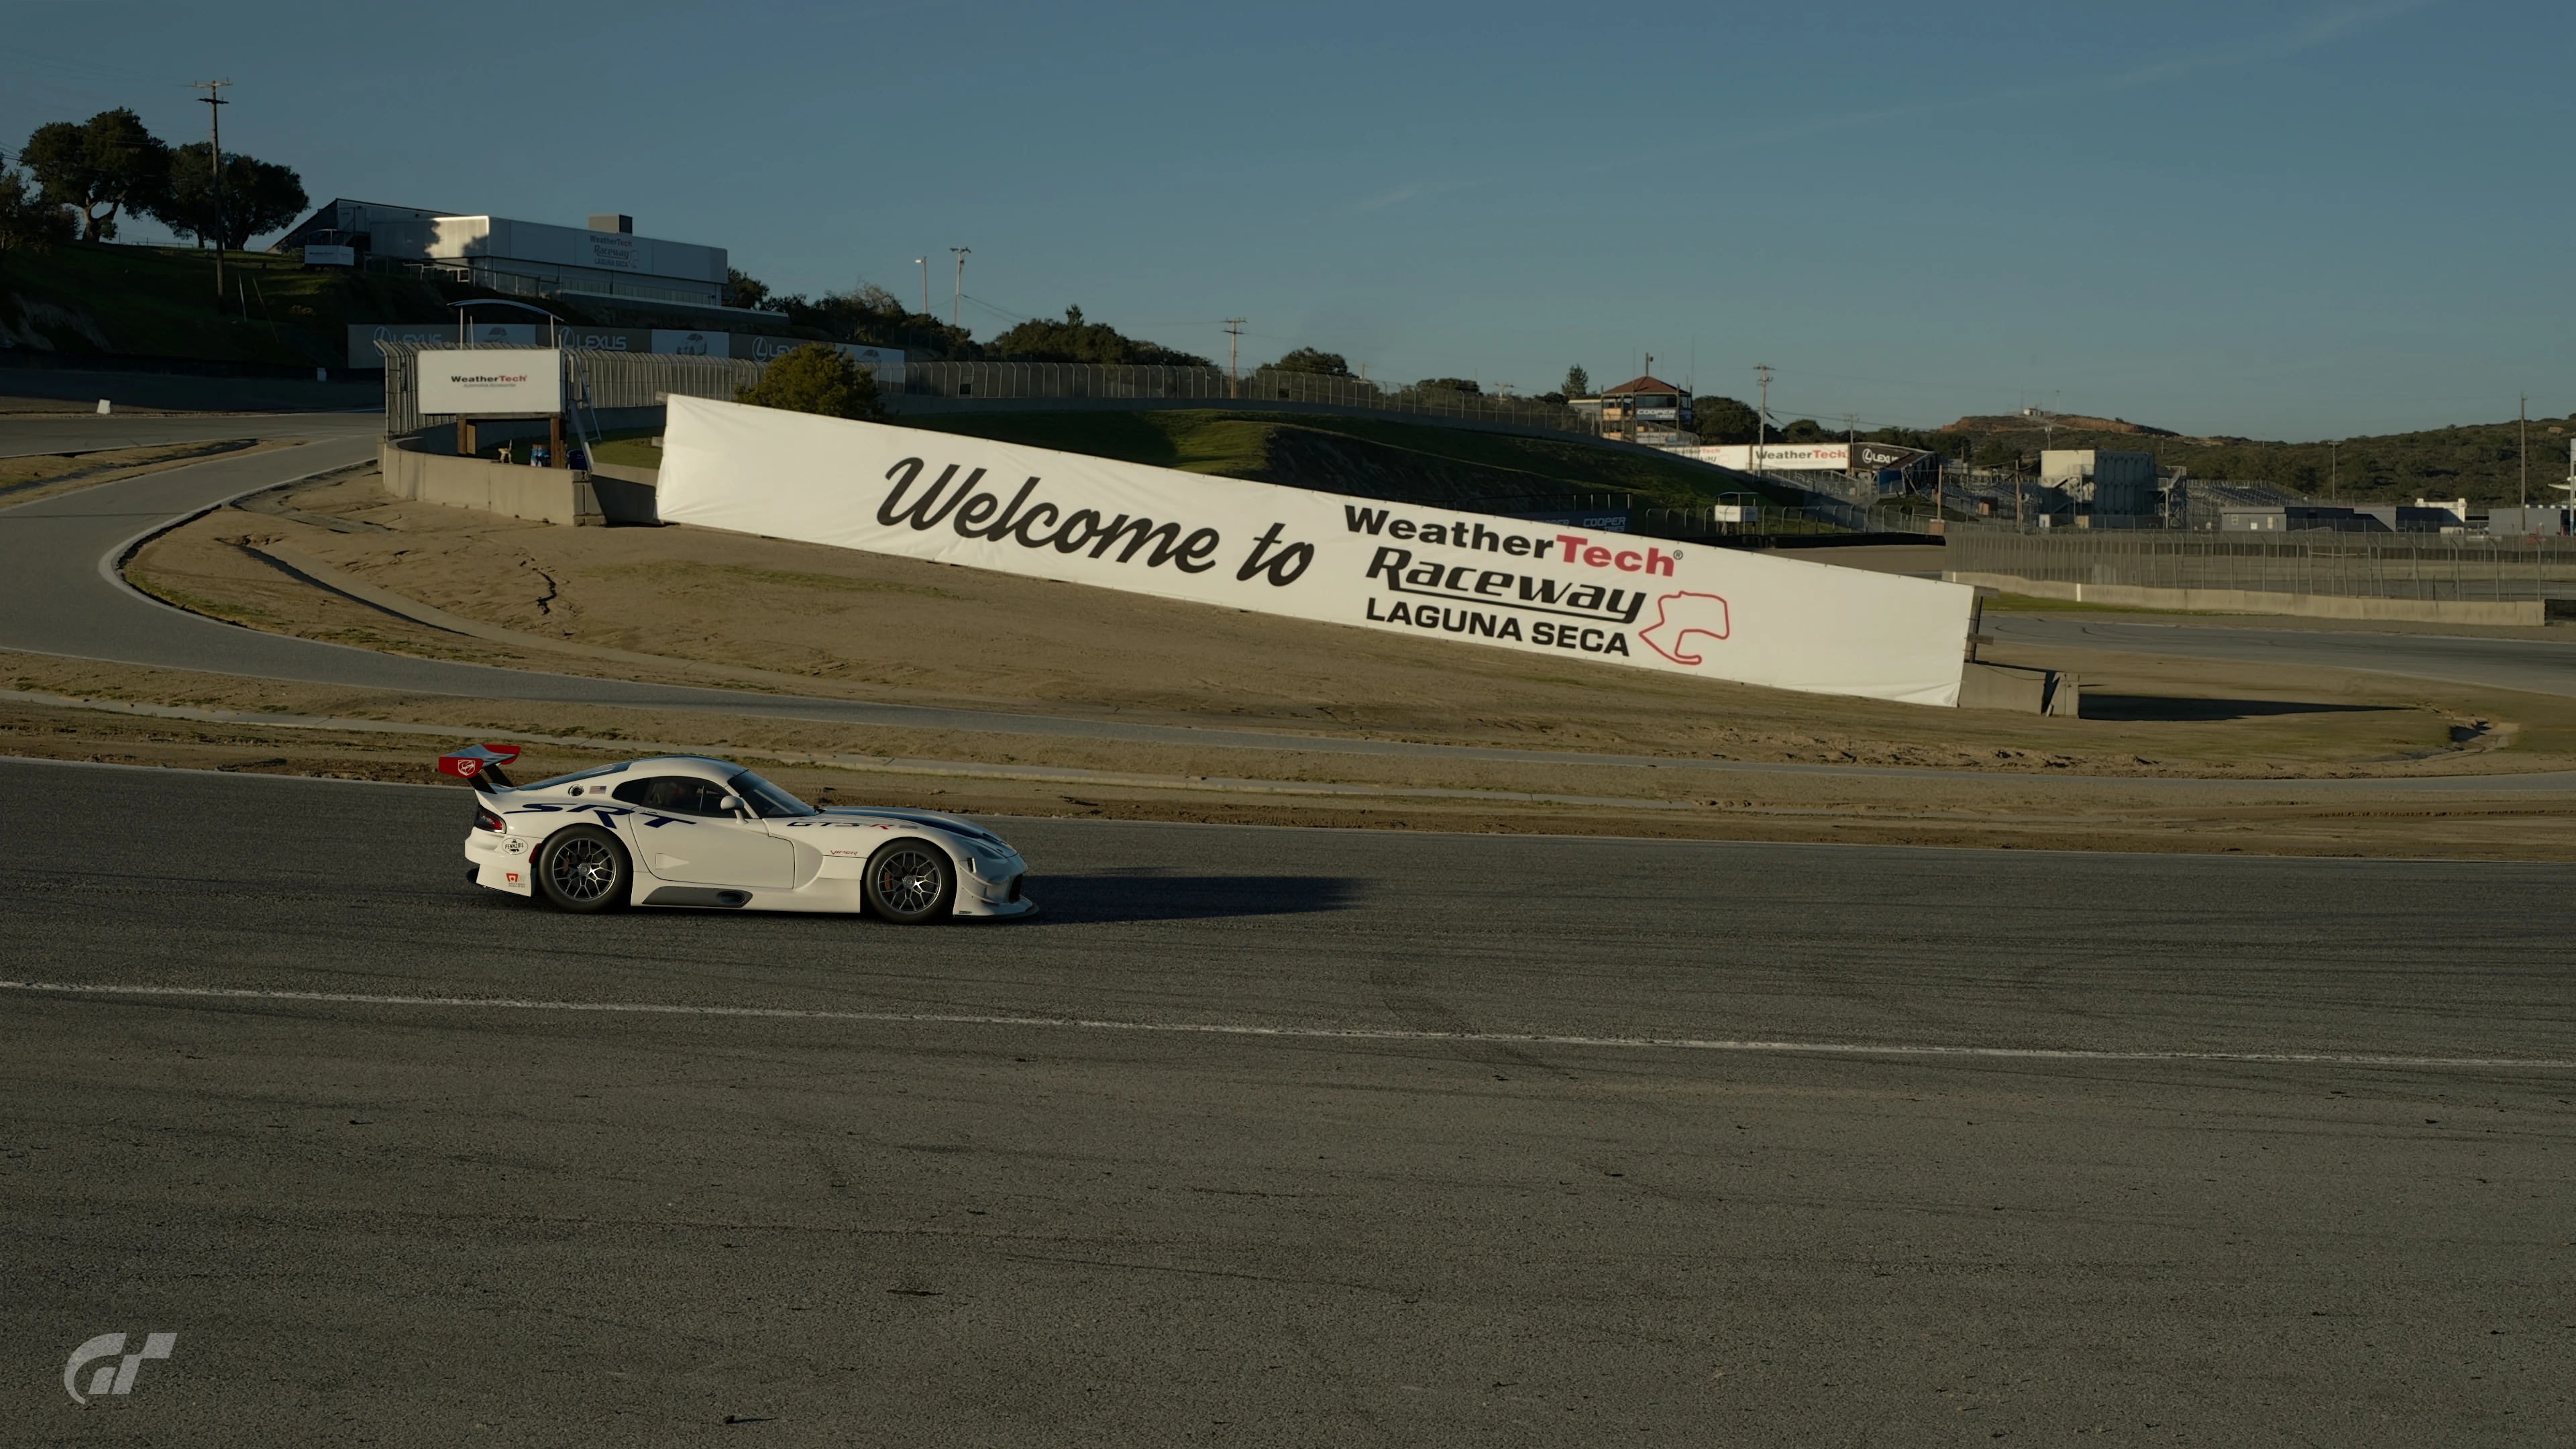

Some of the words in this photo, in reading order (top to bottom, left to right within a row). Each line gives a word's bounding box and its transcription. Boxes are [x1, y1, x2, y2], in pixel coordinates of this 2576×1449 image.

[594, 245, 629, 260] Raceway
[577, 335, 627, 350] LEXUS
[877, 457, 1220, 574] Welcome
[1236, 523, 1315, 586] to
[1583, 517, 1626, 527] COOPER
[1366, 546, 1646, 624] Raceway
[1366, 598, 1522, 642] LAGUNA
[1532, 622, 1629, 657] SECA
[503, 803, 696, 829] SRT
